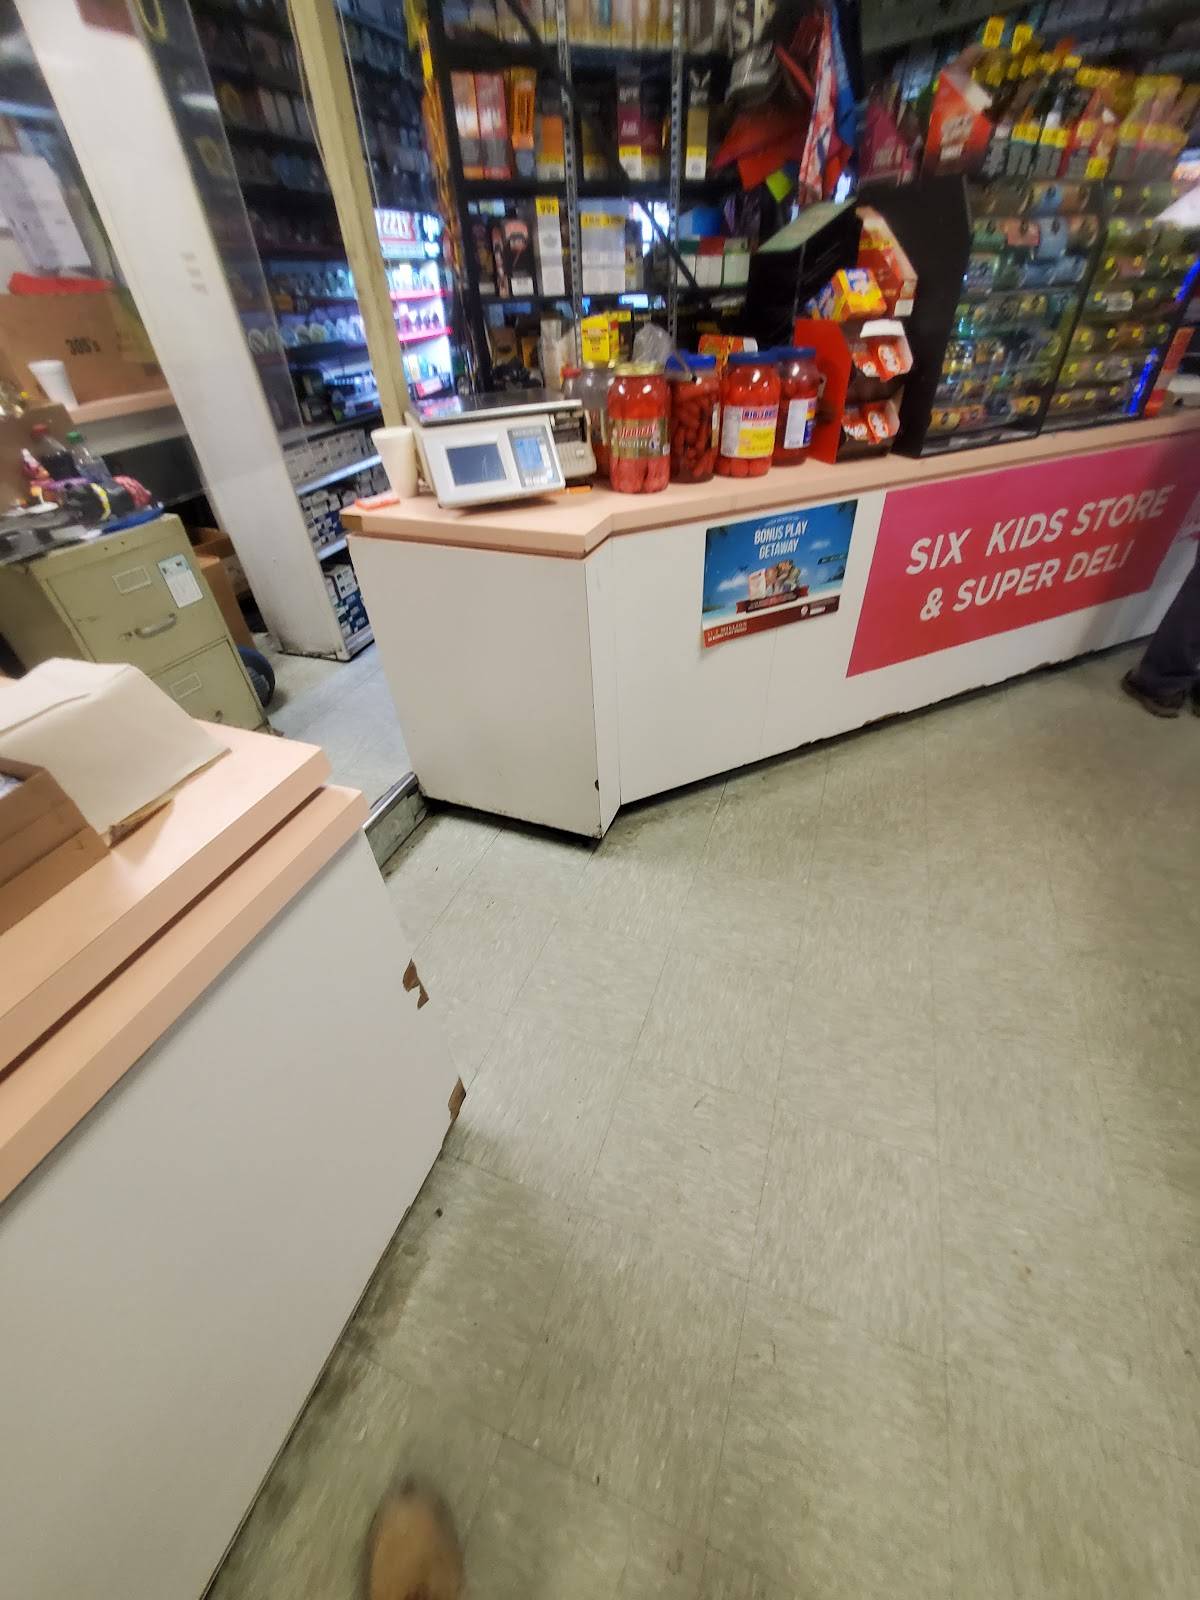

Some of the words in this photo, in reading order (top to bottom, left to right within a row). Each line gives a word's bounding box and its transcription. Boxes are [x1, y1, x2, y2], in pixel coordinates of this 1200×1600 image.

[754, 525, 785, 545] BONUS
[785, 520, 808, 538] PLAY
[759, 538, 800, 560] GETAWAY
[905, 528, 973, 575] SIX
[985, 509, 1068, 557] KIDS
[1070, 484, 1176, 536] STORE
[919, 587, 943, 621] &
[952, 558, 1061, 612] SUPER
[1063, 539, 1135, 584] DELI
